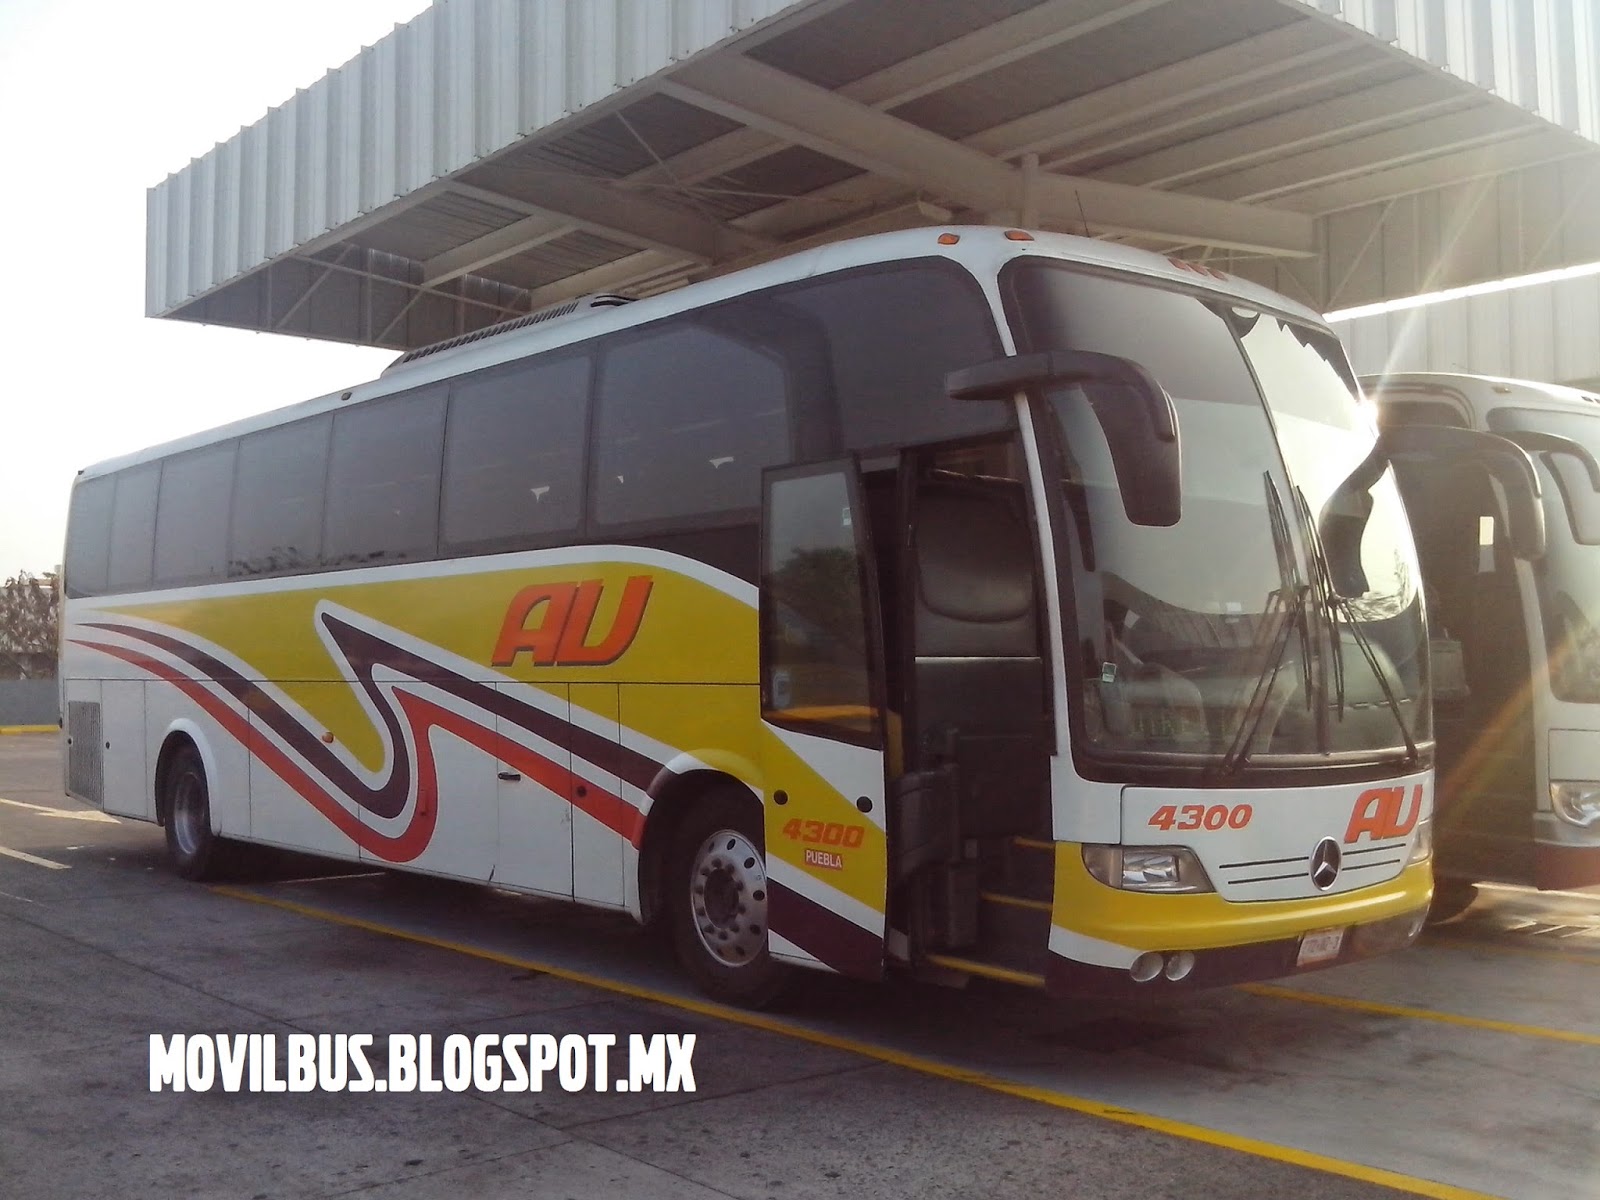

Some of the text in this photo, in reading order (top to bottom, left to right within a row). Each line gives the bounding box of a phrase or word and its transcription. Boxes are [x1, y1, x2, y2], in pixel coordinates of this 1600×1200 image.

[491, 575, 653, 667] AU
[1148, 804, 1252, 830] 4300
[1344, 785, 1422, 843] AU
[782, 818, 865, 848] 4300
[805, 849, 842, 868] PUEBLA
